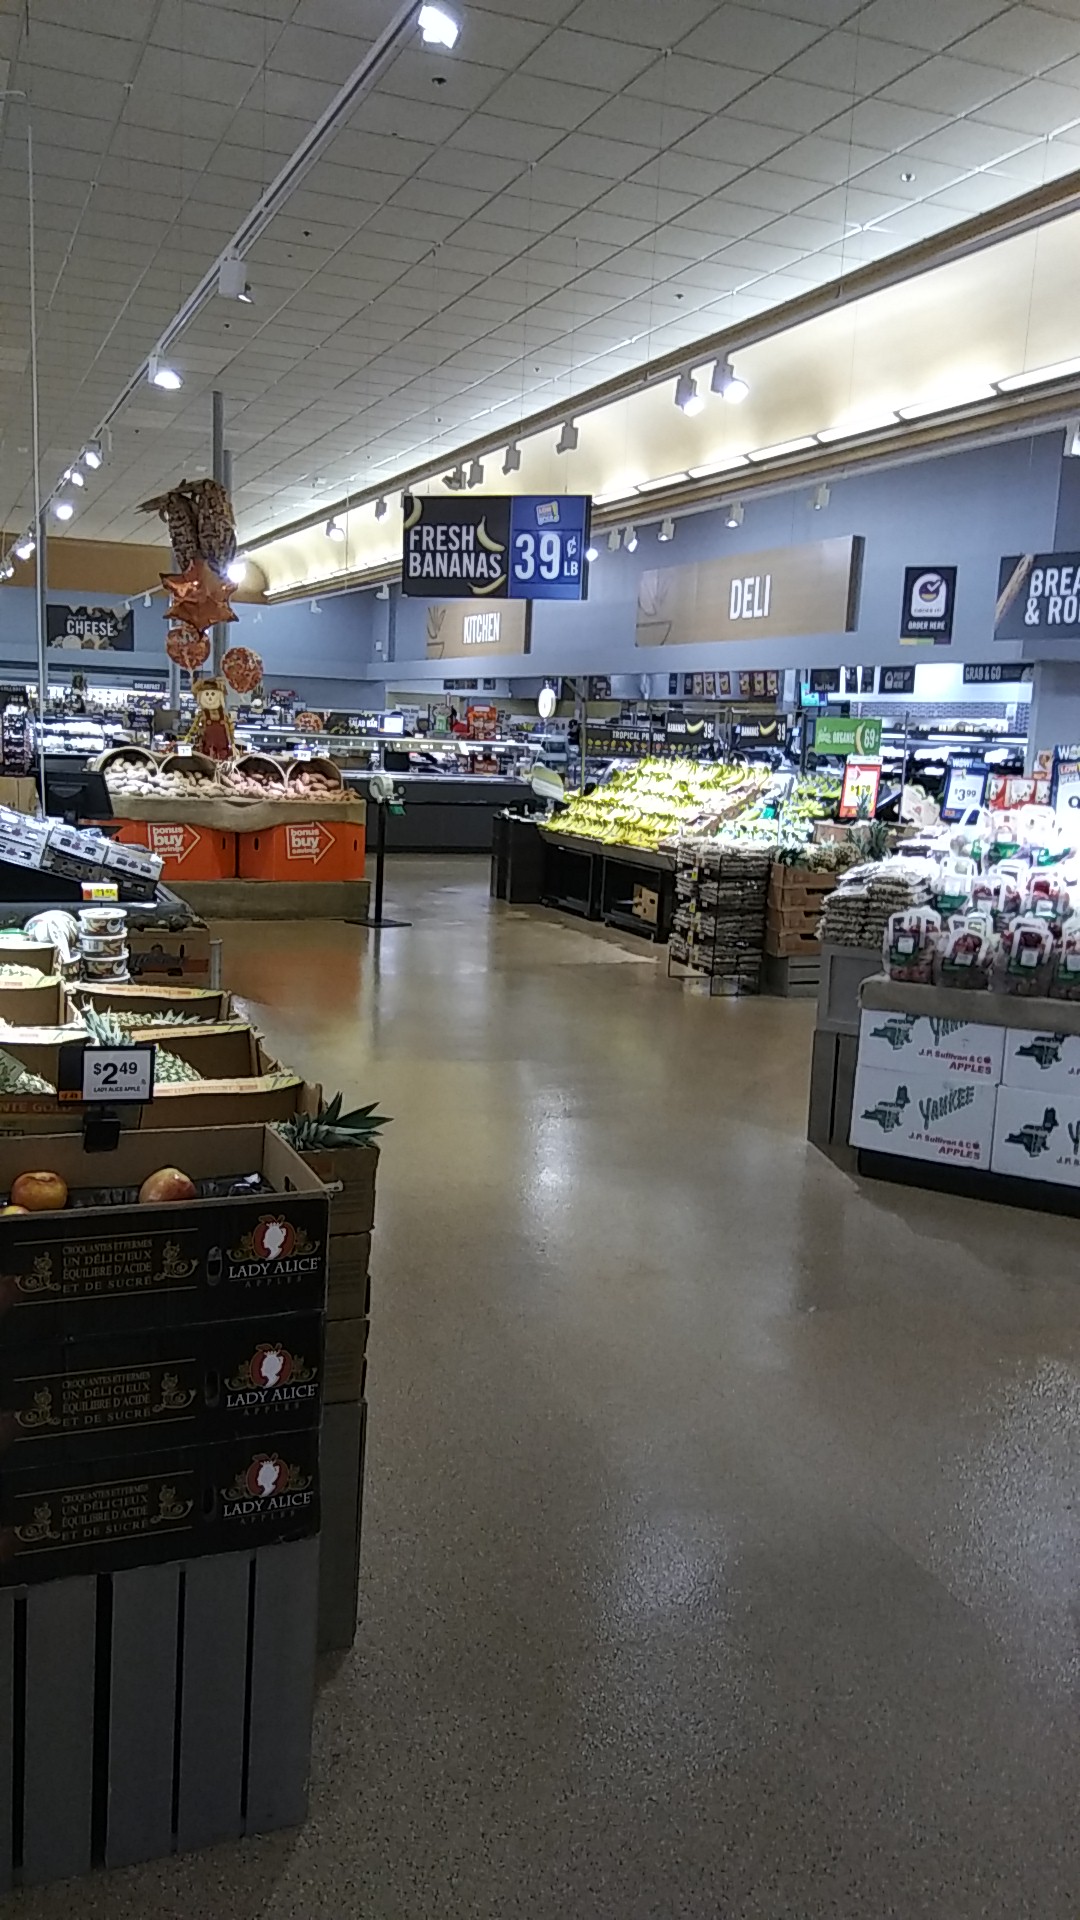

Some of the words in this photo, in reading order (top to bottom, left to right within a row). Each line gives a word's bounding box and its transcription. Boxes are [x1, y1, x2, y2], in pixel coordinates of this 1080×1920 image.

[409, 525, 475, 551] FRESH
[408, 552, 502, 578] BANANAS
[564, 561, 579, 576] LB
[730, 574, 771, 620] DELI
[1024, 597, 1041, 625] &
[1047, 596, 1080, 625] RO
[66, 620, 115, 637] CHEESE
[463, 612, 500, 644] KITCHEN
[908, 621, 929, 630] ORDER
[929, 620, 945, 631] HERE
[965, 666, 983, 681] GRAB
[991, 666, 1001, 680] GO
[134, 682, 161, 690] BREAKFAST
[612, 730, 640, 740] TROPICAL
[667, 722, 686, 733] BANANAS
[740, 725, 760, 737] BANANAS
[832, 733, 855, 744] ORGANIC
[152, 826, 184, 835] bonus
[290, 827, 320, 837] bonus
[153, 833, 184, 847] buy
[291, 835, 319, 849] buy
[949, 1062, 992, 1075] APPLES
[919, 1085, 975, 1131] YANKEE
[938, 1146, 980, 1160] APPLES
[63, 1256, 80, 1267] UN
[84, 1250, 152, 1265] DÉLICIEUX
[63, 1265, 112, 1280] ÉQUILIBRE
[229, 1262, 271, 1279] LADY
[273, 1257, 318, 1274] ALICE
[62, 1283, 79, 1294] ET
[85, 1281, 101, 1291] DE
[107, 1275, 151, 1289] SUCRE
[62, 1391, 80, 1400] UN
[226, 1390, 269, 1408] LADY
[271, 1383, 316, 1402] ALICE
[62, 1417, 79, 1427] ET
[84, 1415, 100, 1425] DE
[107, 1408, 150, 1422] SUCRE
[223, 1499, 266, 1517] LADY
[267, 1491, 312, 1511] ALICE
